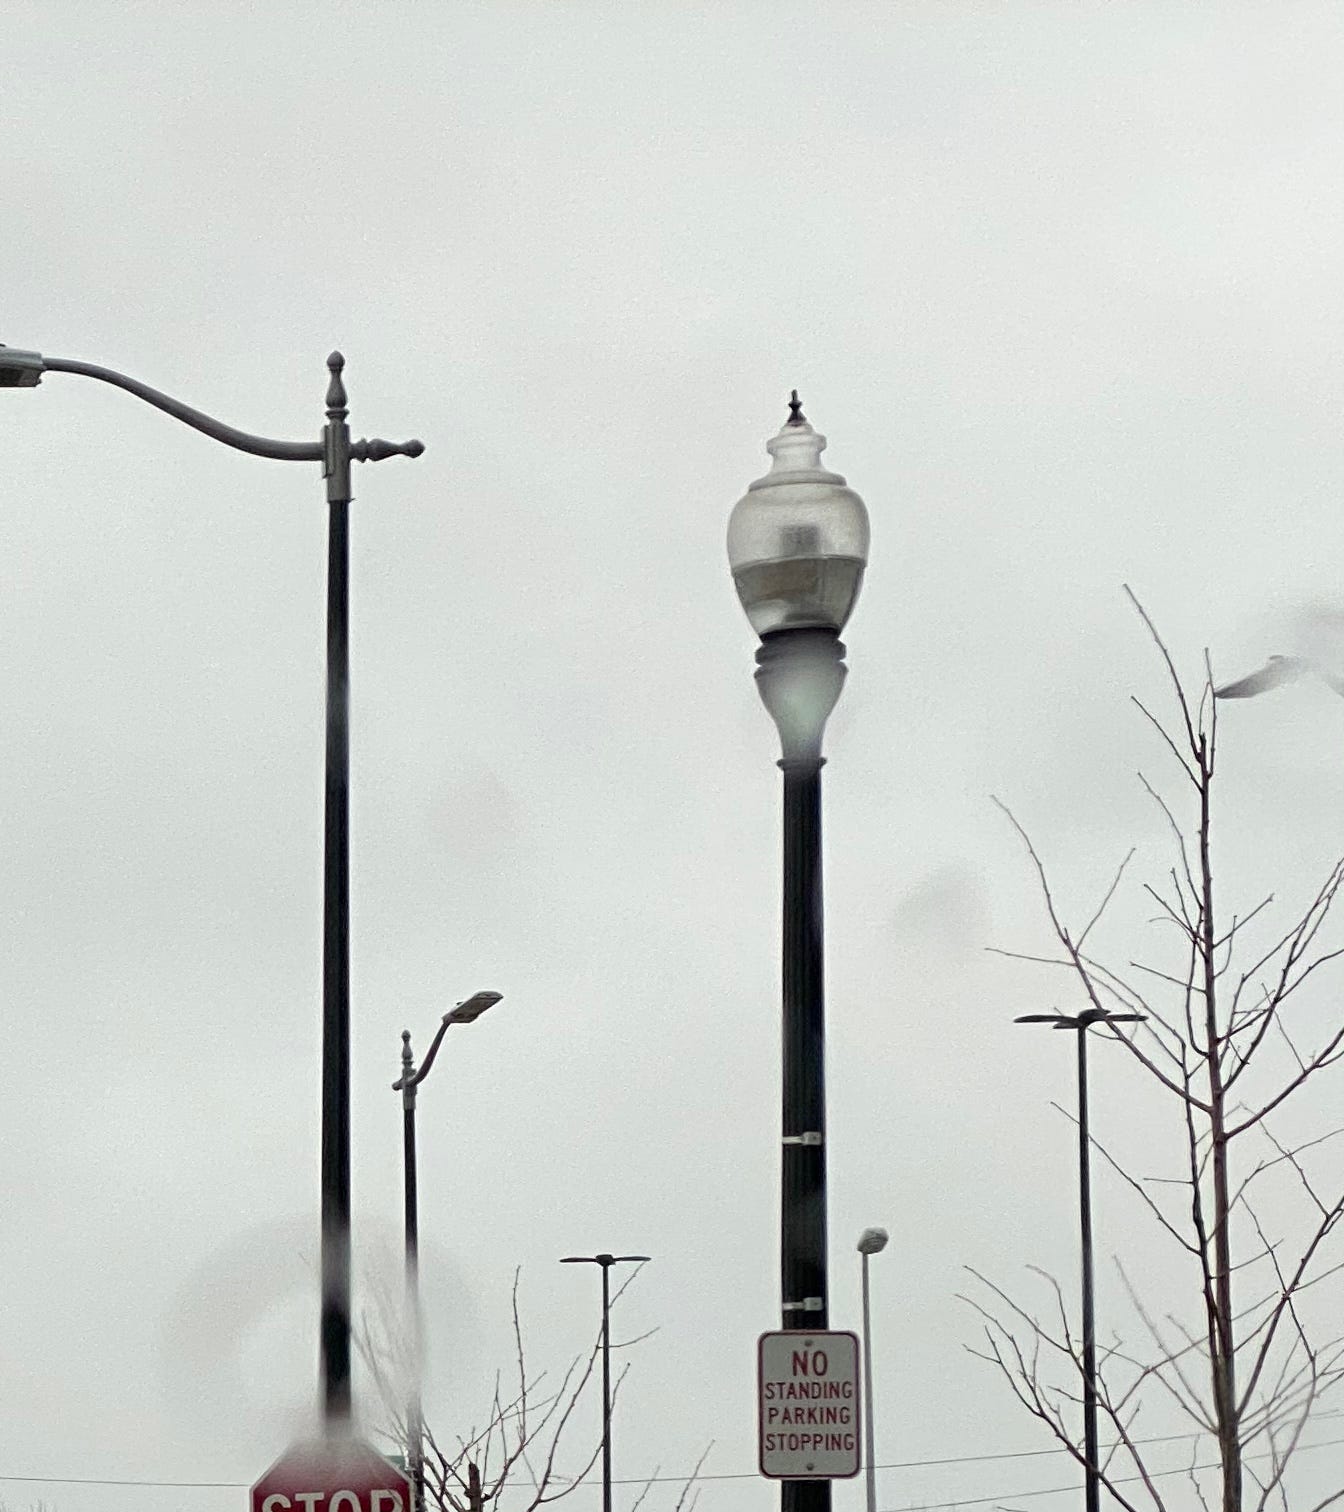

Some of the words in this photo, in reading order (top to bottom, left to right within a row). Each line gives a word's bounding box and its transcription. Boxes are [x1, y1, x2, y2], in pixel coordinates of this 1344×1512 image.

[792, 1351, 828, 1376] NO
[765, 1381, 853, 1400] STANDING
[768, 1407, 851, 1425] PARKING
[766, 1433, 855, 1451] STOPPING
